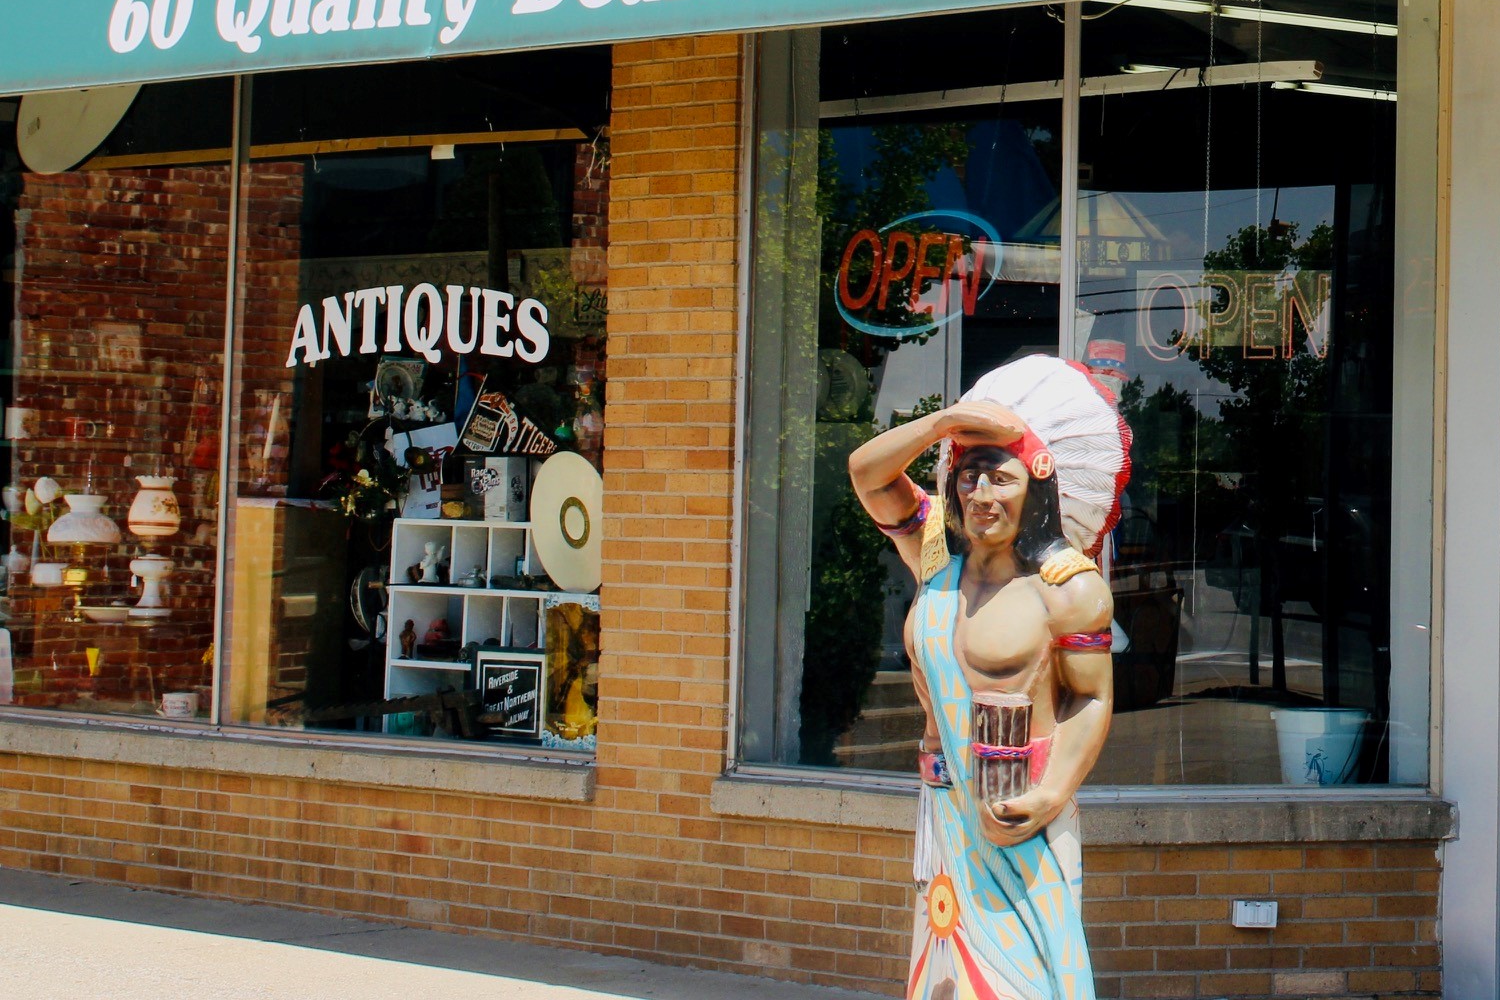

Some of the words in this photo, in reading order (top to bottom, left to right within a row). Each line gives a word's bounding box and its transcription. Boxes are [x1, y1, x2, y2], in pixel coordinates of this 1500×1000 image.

[838, 227, 988, 316] OPEN
[285, 282, 550, 368] ANTIQUES
[1139, 270, 1332, 361] OPEN
[507, 684, 513, 694] &
